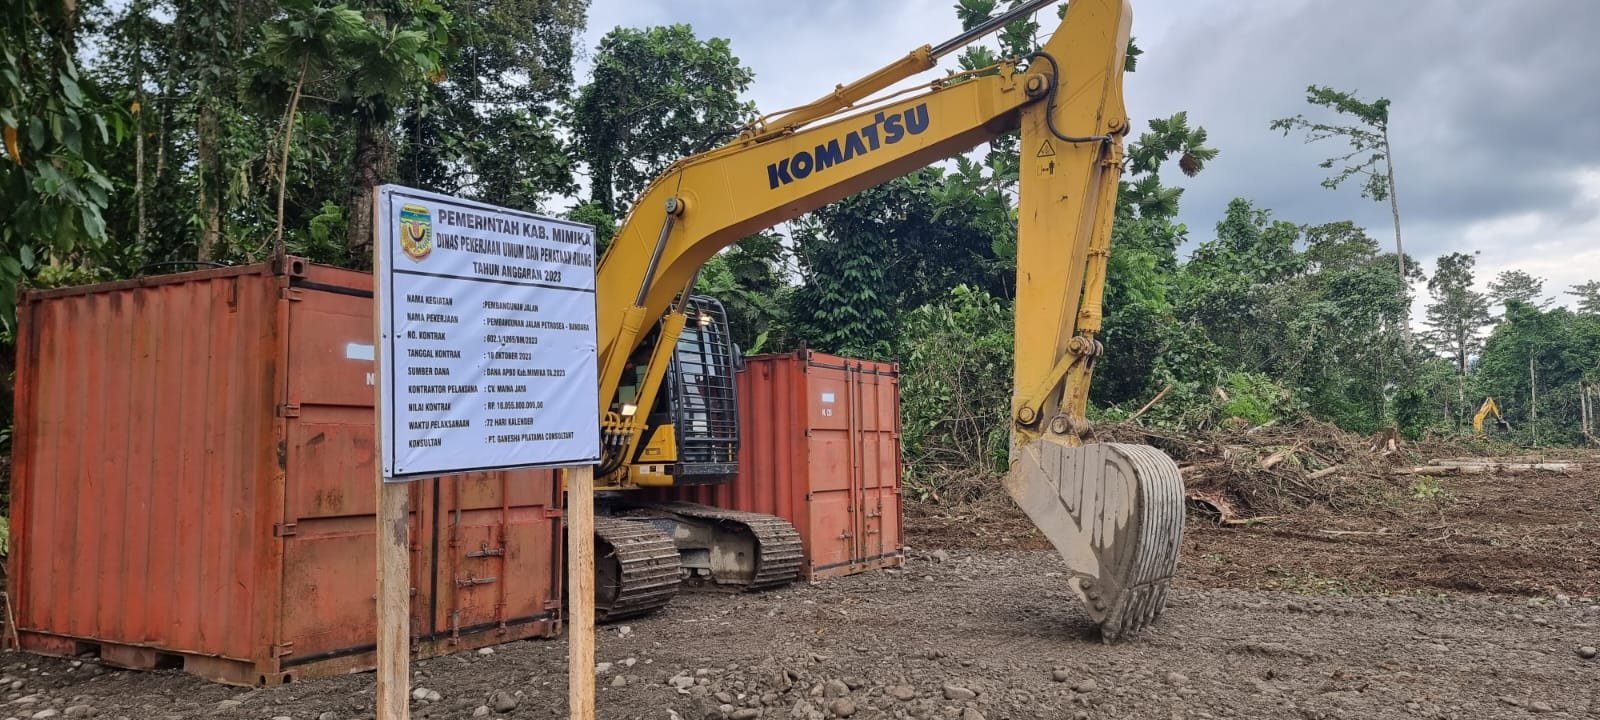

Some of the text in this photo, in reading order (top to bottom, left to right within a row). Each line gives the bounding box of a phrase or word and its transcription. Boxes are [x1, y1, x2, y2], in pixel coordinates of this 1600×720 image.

[767, 103, 930, 190] KOMATSU
[438, 209, 519, 235] PEMERINTAH
[523, 222, 549, 240] KAB.
[552, 228, 591, 247] MIMIKA
[436, 233, 592, 268] DINAS PEKERJAAN UMUM DAN PENATAAN RUANG
[473, 261, 562, 283] TAHUN ANGGARAN 2023
[406, 294, 453, 306] NAMA KEGIATAN
[523, 303, 539, 312] JALAN
[407, 312, 459, 324] NAMA PEKERJAAN
[486, 317, 525, 328] PEMBANGUNAN
[525, 320, 541, 329] JALAN
[541, 321, 565, 330] PETROSEA
[407, 330, 446, 341] NO. KONTRAK
[407, 349, 461, 359] TANGGAL KONTRAK
[495, 351, 518, 361] OKTOBER
[407, 367, 450, 376] SUMBER DANA
[486, 368, 501, 376] DANA
[502, 368, 516, 376] APBD
[407, 385, 447, 394] KONTRAKTOR
[408, 402, 451, 412] NILAI KONTRAK
[408, 419, 470, 430] WAKTU PELAKSANAAN
[494, 418, 507, 426] HARI
[508, 417, 534, 426] KALENDER
[497, 434, 521, 443] GANESHA
[521, 433, 544, 442] PRATAMA
[545, 431, 574, 441] CONSULTANT
[408, 438, 442, 449] KONSULTAN
